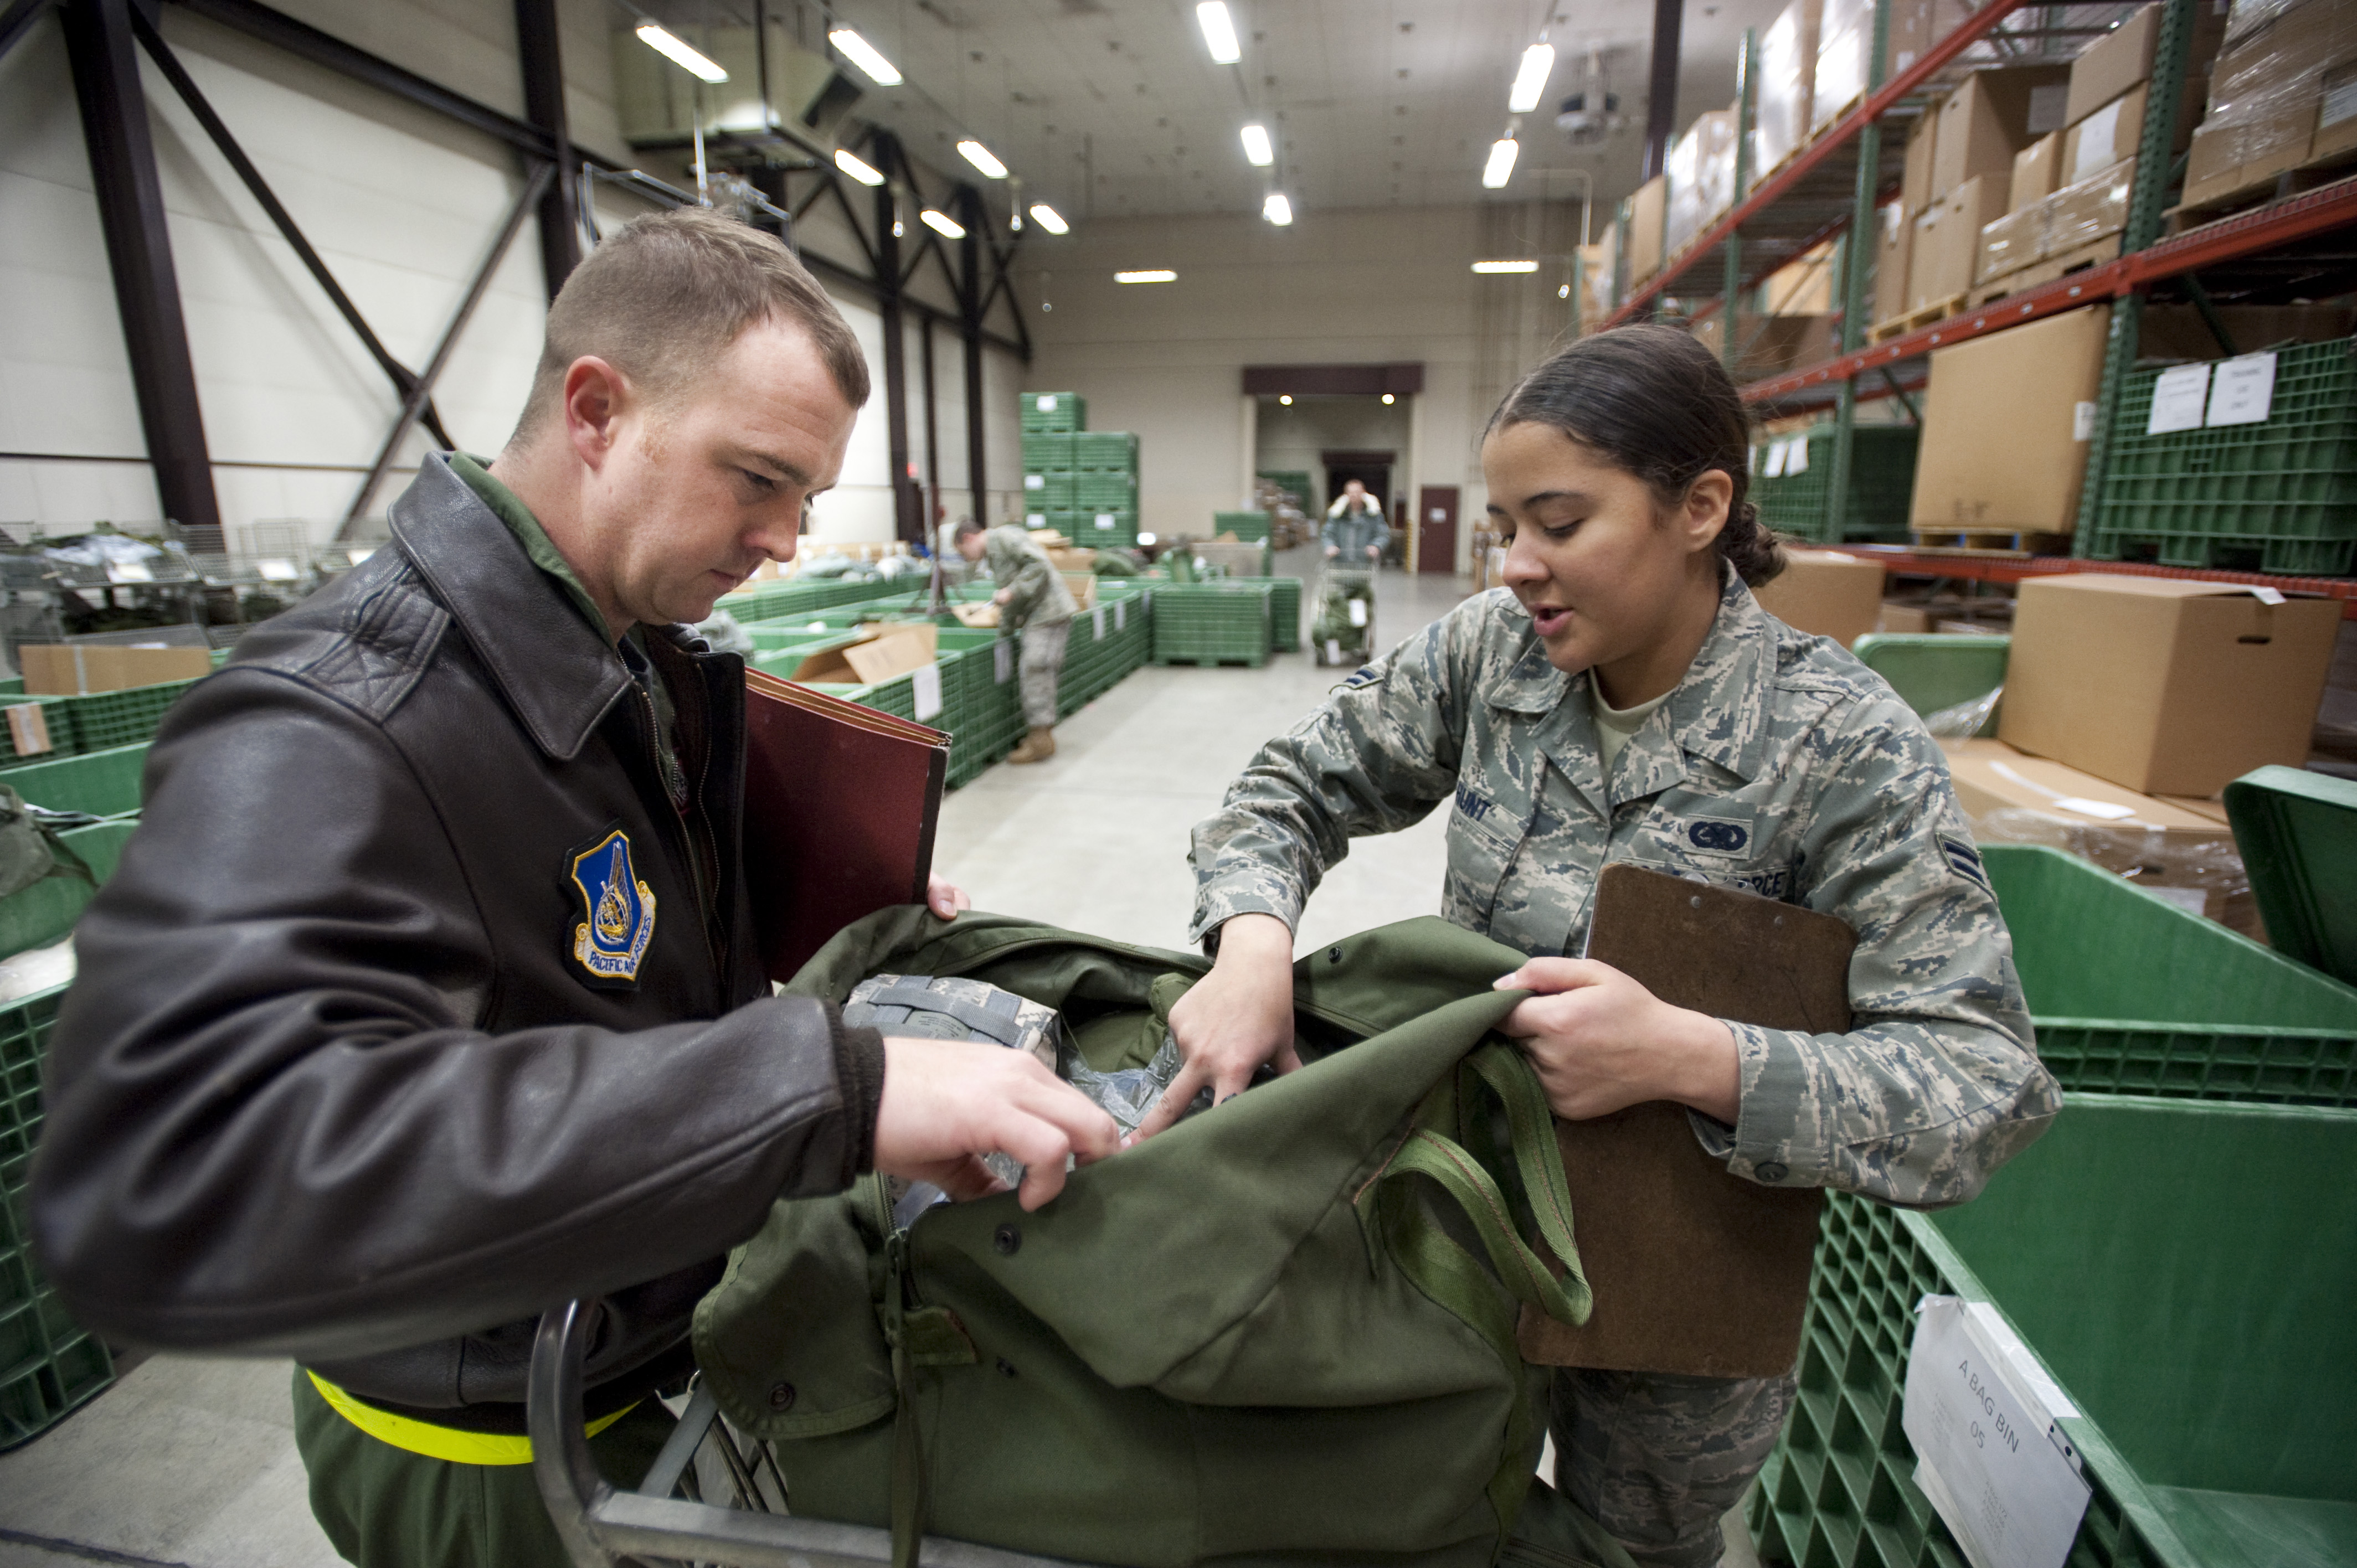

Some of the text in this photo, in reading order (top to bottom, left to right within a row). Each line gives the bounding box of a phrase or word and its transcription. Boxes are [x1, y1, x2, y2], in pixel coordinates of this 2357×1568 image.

[588, 915, 651, 973] PACIFIC AIR FORCES
[1959, 1360, 1968, 1378] A
[1969, 1373, 1995, 1416] BAG
[1995, 1413, 2019, 1453] BIN
